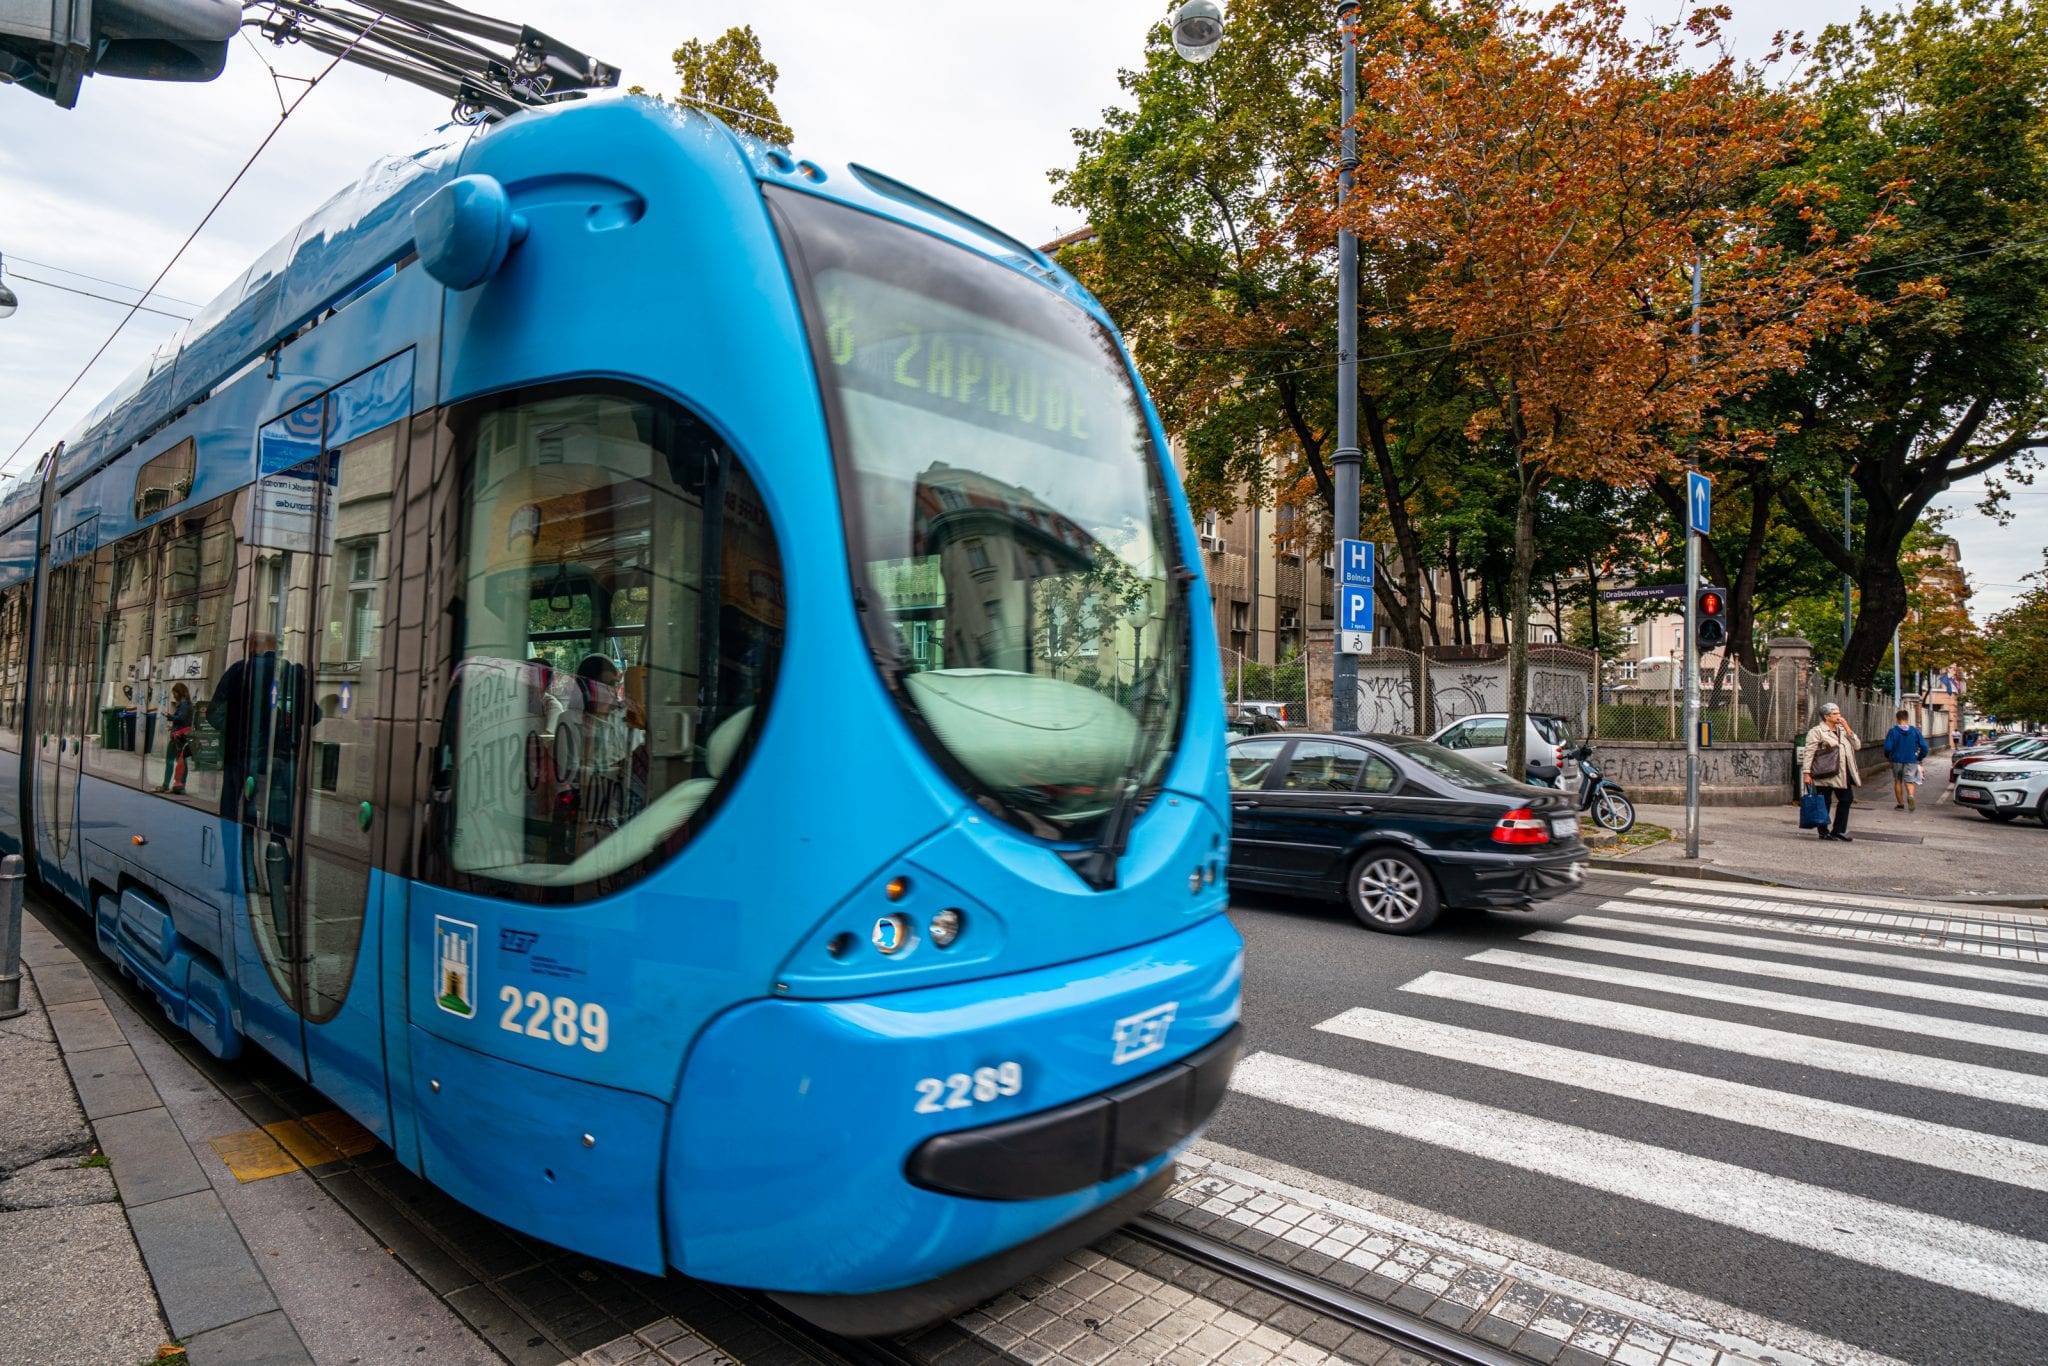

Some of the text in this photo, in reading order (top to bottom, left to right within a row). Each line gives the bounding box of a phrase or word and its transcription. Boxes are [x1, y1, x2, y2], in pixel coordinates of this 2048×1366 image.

[1351, 544, 1366, 570] H
[1346, 572, 1371, 583] Bolnica
[1605, 589, 1649, 599] Draškovićeva
[1351, 594, 1365, 622] P
[499, 985, 609, 1053] 2289
[913, 1060, 1023, 1114] 2289
